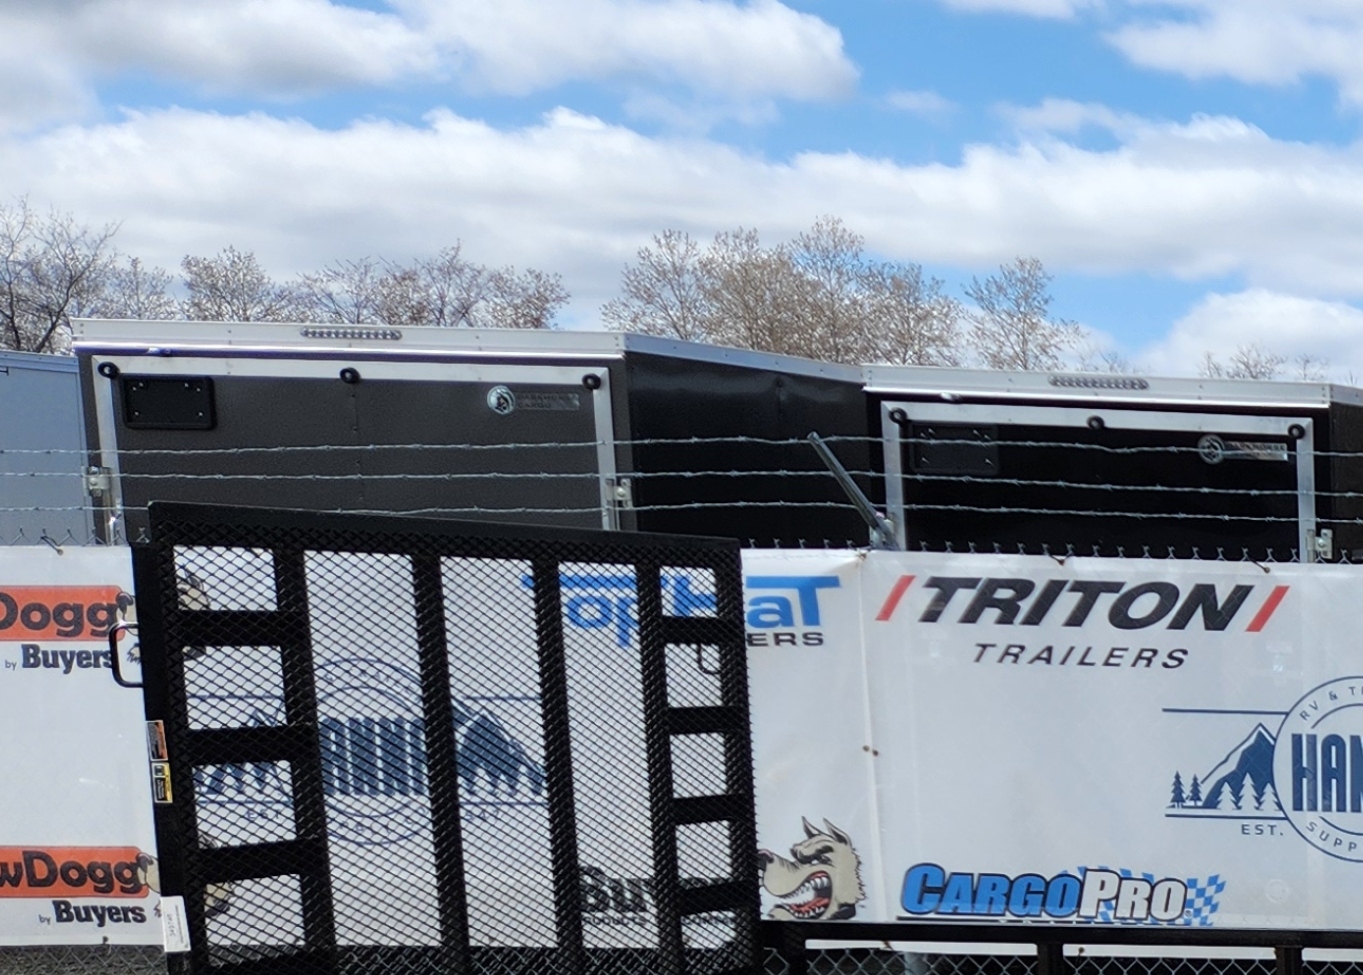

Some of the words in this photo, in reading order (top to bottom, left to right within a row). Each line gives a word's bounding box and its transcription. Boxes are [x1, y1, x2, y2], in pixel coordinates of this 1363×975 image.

[917, 575, 1255, 632] TRITON
[4, 659, 18, 671] by
[973, 643, 1189, 669] TRAILERS
[1299, 701, 1319, 721] RV
[1328, 690, 1339, 701] &
[1241, 823, 1284, 837] EST.
[39, 914, 52, 926] by
[52, 899, 148, 928] Buyers
